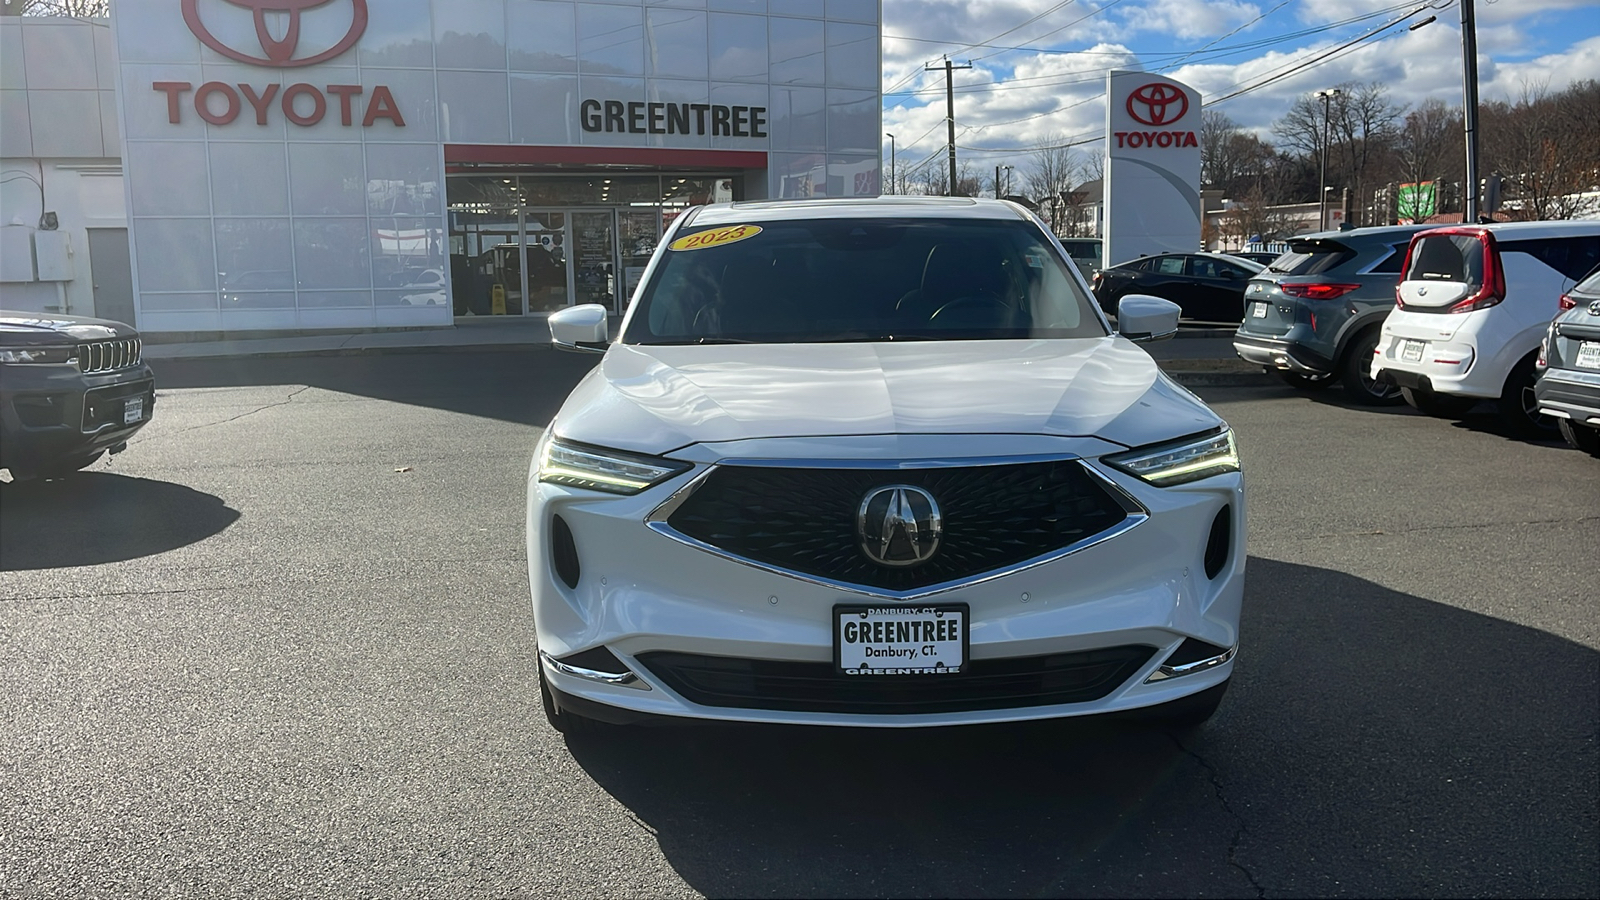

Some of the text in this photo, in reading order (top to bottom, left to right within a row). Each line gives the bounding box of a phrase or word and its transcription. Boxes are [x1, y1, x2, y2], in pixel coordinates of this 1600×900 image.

[152, 81, 406, 127] TOYOTA
[580, 98, 767, 138] GREENTREE
[1114, 131, 1198, 148] TOYOTA
[684, 227, 746, 248] 2023
[844, 620, 958, 644] GREENTREE
[865, 645, 938, 660] Danbury, CT.
[845, 666, 960, 675] GREENTREE
